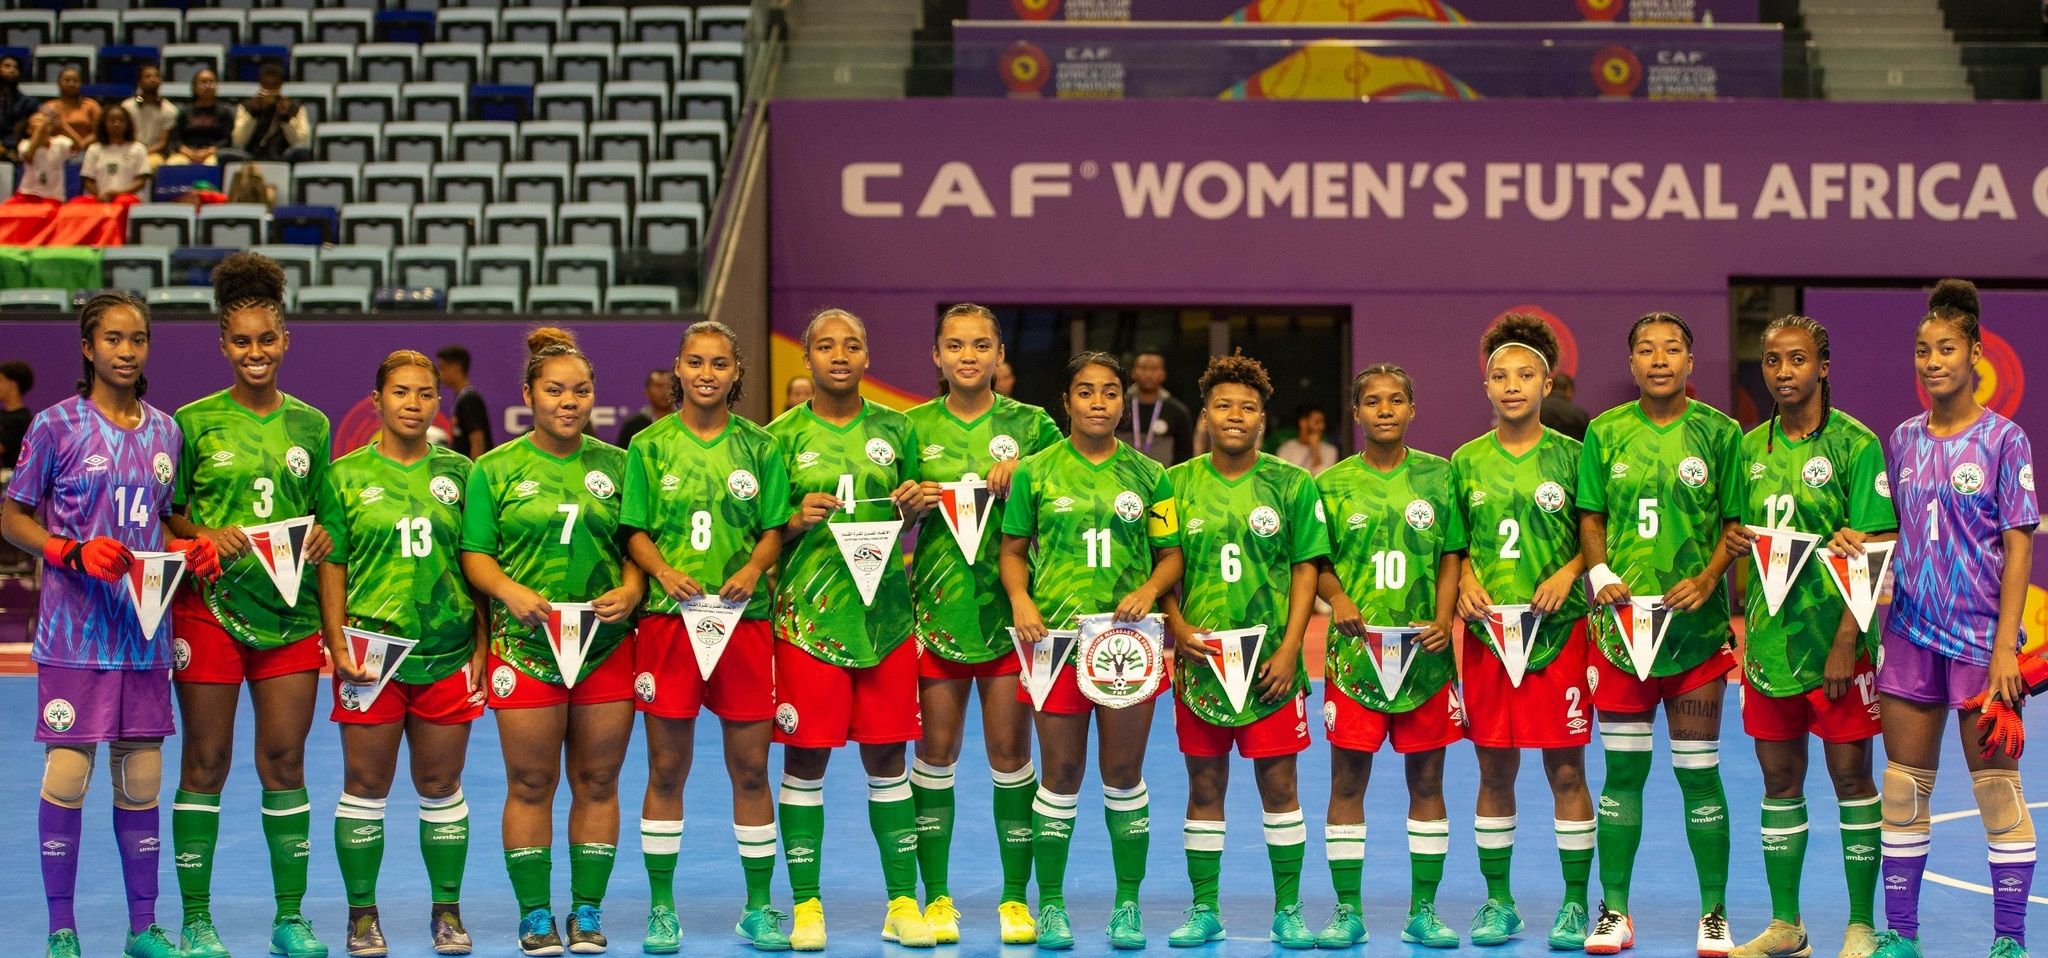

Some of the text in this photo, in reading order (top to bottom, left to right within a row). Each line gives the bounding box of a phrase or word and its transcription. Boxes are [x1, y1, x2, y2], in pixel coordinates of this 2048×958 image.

[1112, 160, 1469, 220] WOMEN'S
[1485, 161, 1738, 221] FUTSAL
[1752, 161, 2018, 221] AFRICA
[115, 486, 149, 528] 14
[253, 477, 274, 518] 3
[836, 474, 856, 514] 4
[1763, 494, 1796, 532] 12
[395, 516, 432, 557] 13
[557, 503, 579, 544] 7
[690, 510, 712, 551] 8
[1349, 523, 1367, 531] umbro
[1498, 518, 1521, 558] 2
[1638, 498, 1659, 539] 5
[1926, 498, 1939, 541] 1
[1082, 528, 1111, 567] 11
[1220, 543, 1242, 582] 6
[1371, 550, 1406, 589] 10
[1565, 686, 1583, 718] 2
[1854, 671, 1880, 705] 12
[1569, 727, 1588, 735] umbro
[1041, 830, 1068, 839] umbro
[1691, 814, 1723, 822] umbro
[352, 834, 382, 844] umbro
[510, 849, 542, 858] umbro
[583, 849, 613, 857] umbro
